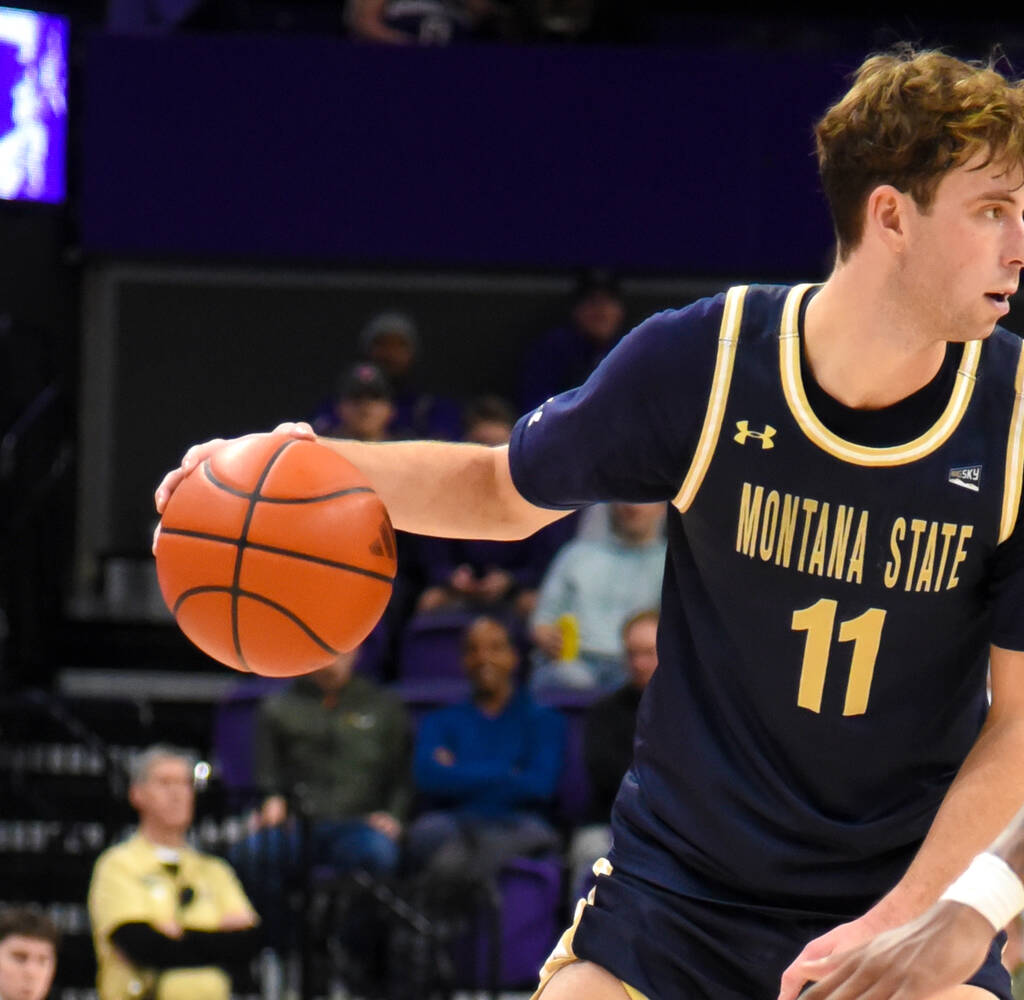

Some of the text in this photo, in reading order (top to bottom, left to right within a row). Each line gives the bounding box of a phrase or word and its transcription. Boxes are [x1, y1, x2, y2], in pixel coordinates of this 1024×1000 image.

[736, 482, 973, 592] MONTANA STATE
[791, 598, 887, 717] 11
